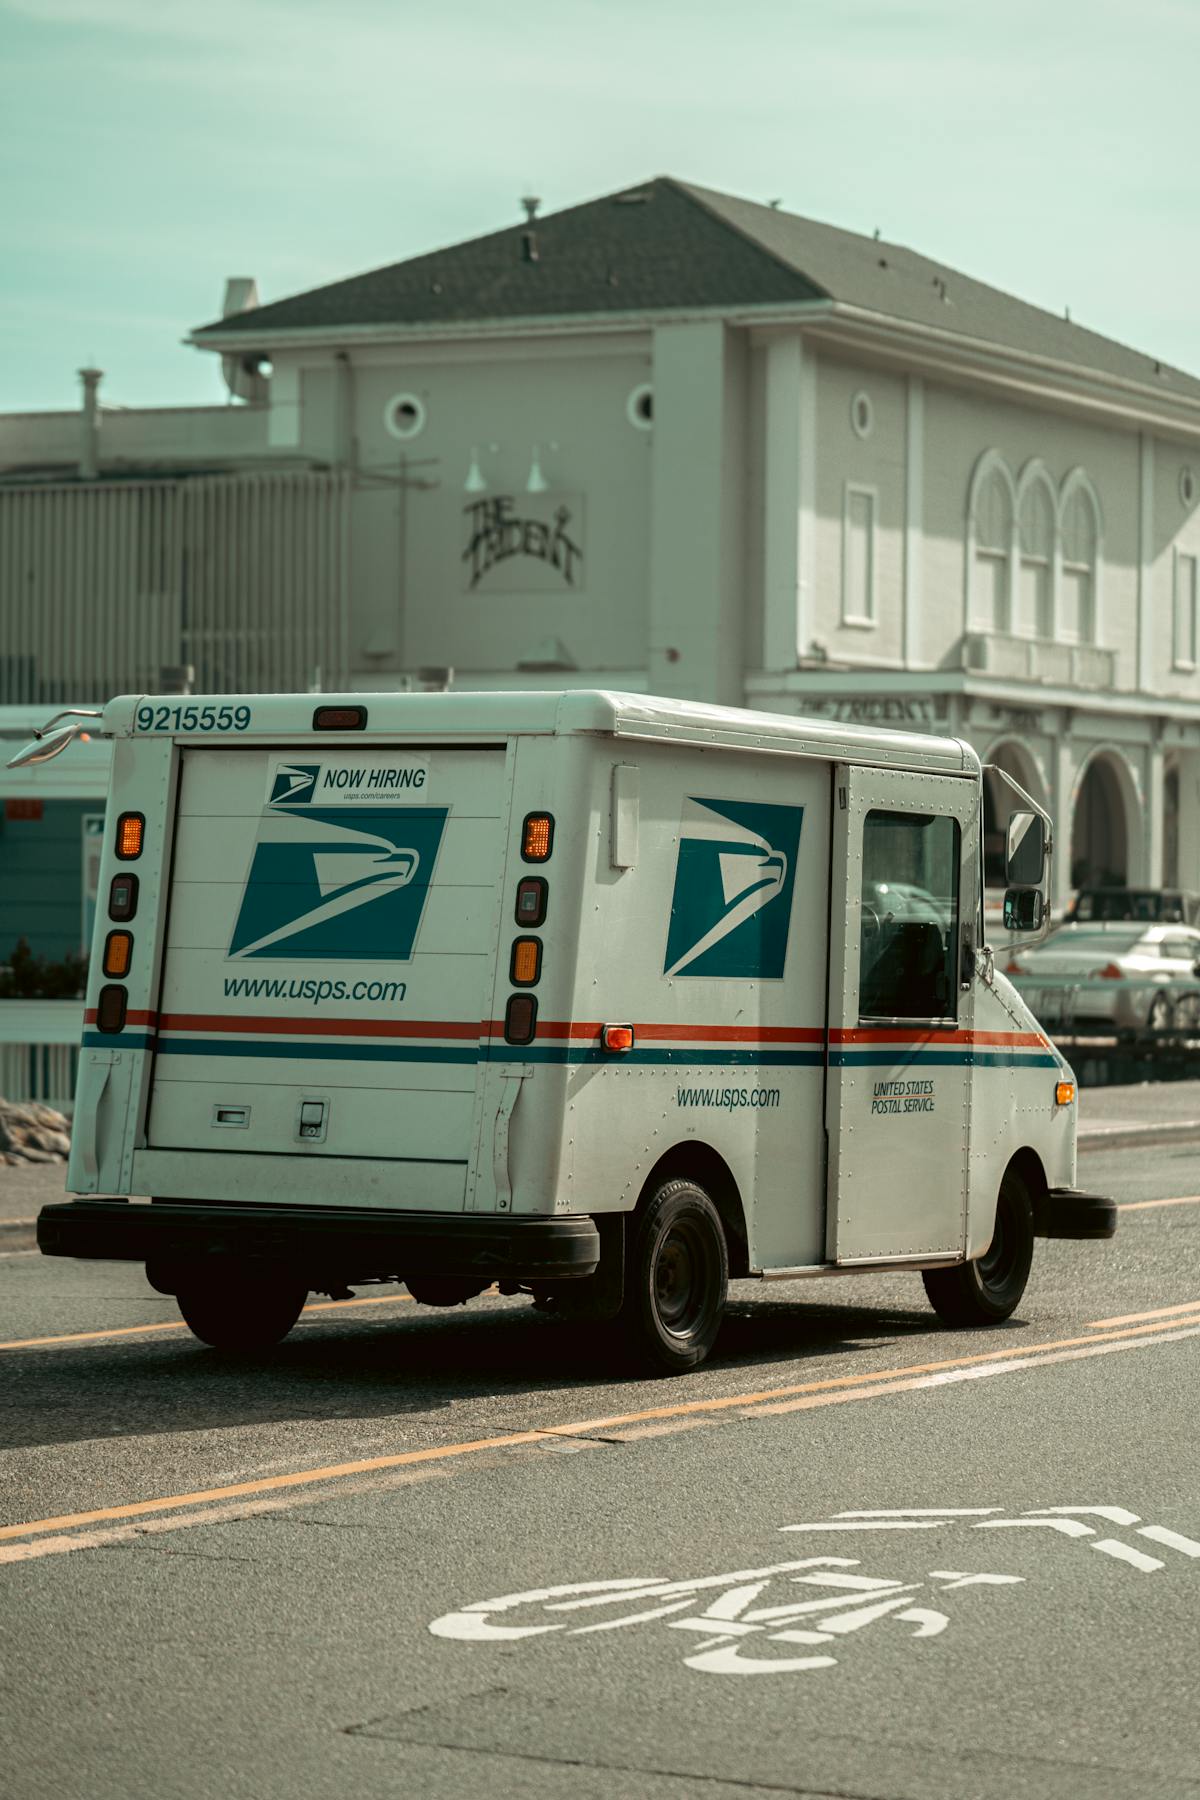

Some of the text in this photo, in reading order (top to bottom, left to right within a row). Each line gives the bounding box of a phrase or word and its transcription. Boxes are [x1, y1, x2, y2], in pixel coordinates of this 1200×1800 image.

[137, 705, 251, 731] 9215559
[323, 768, 426, 789] NOW HIRING
[343, 792, 401, 801] usps.com/careers
[223, 978, 407, 1005] www.usps.com
[873, 1080, 934, 1096] UNITED STATES
[676, 1087, 780, 1112] www.usps.com
[871, 1098, 935, 1115] POSTAL SERVICE
